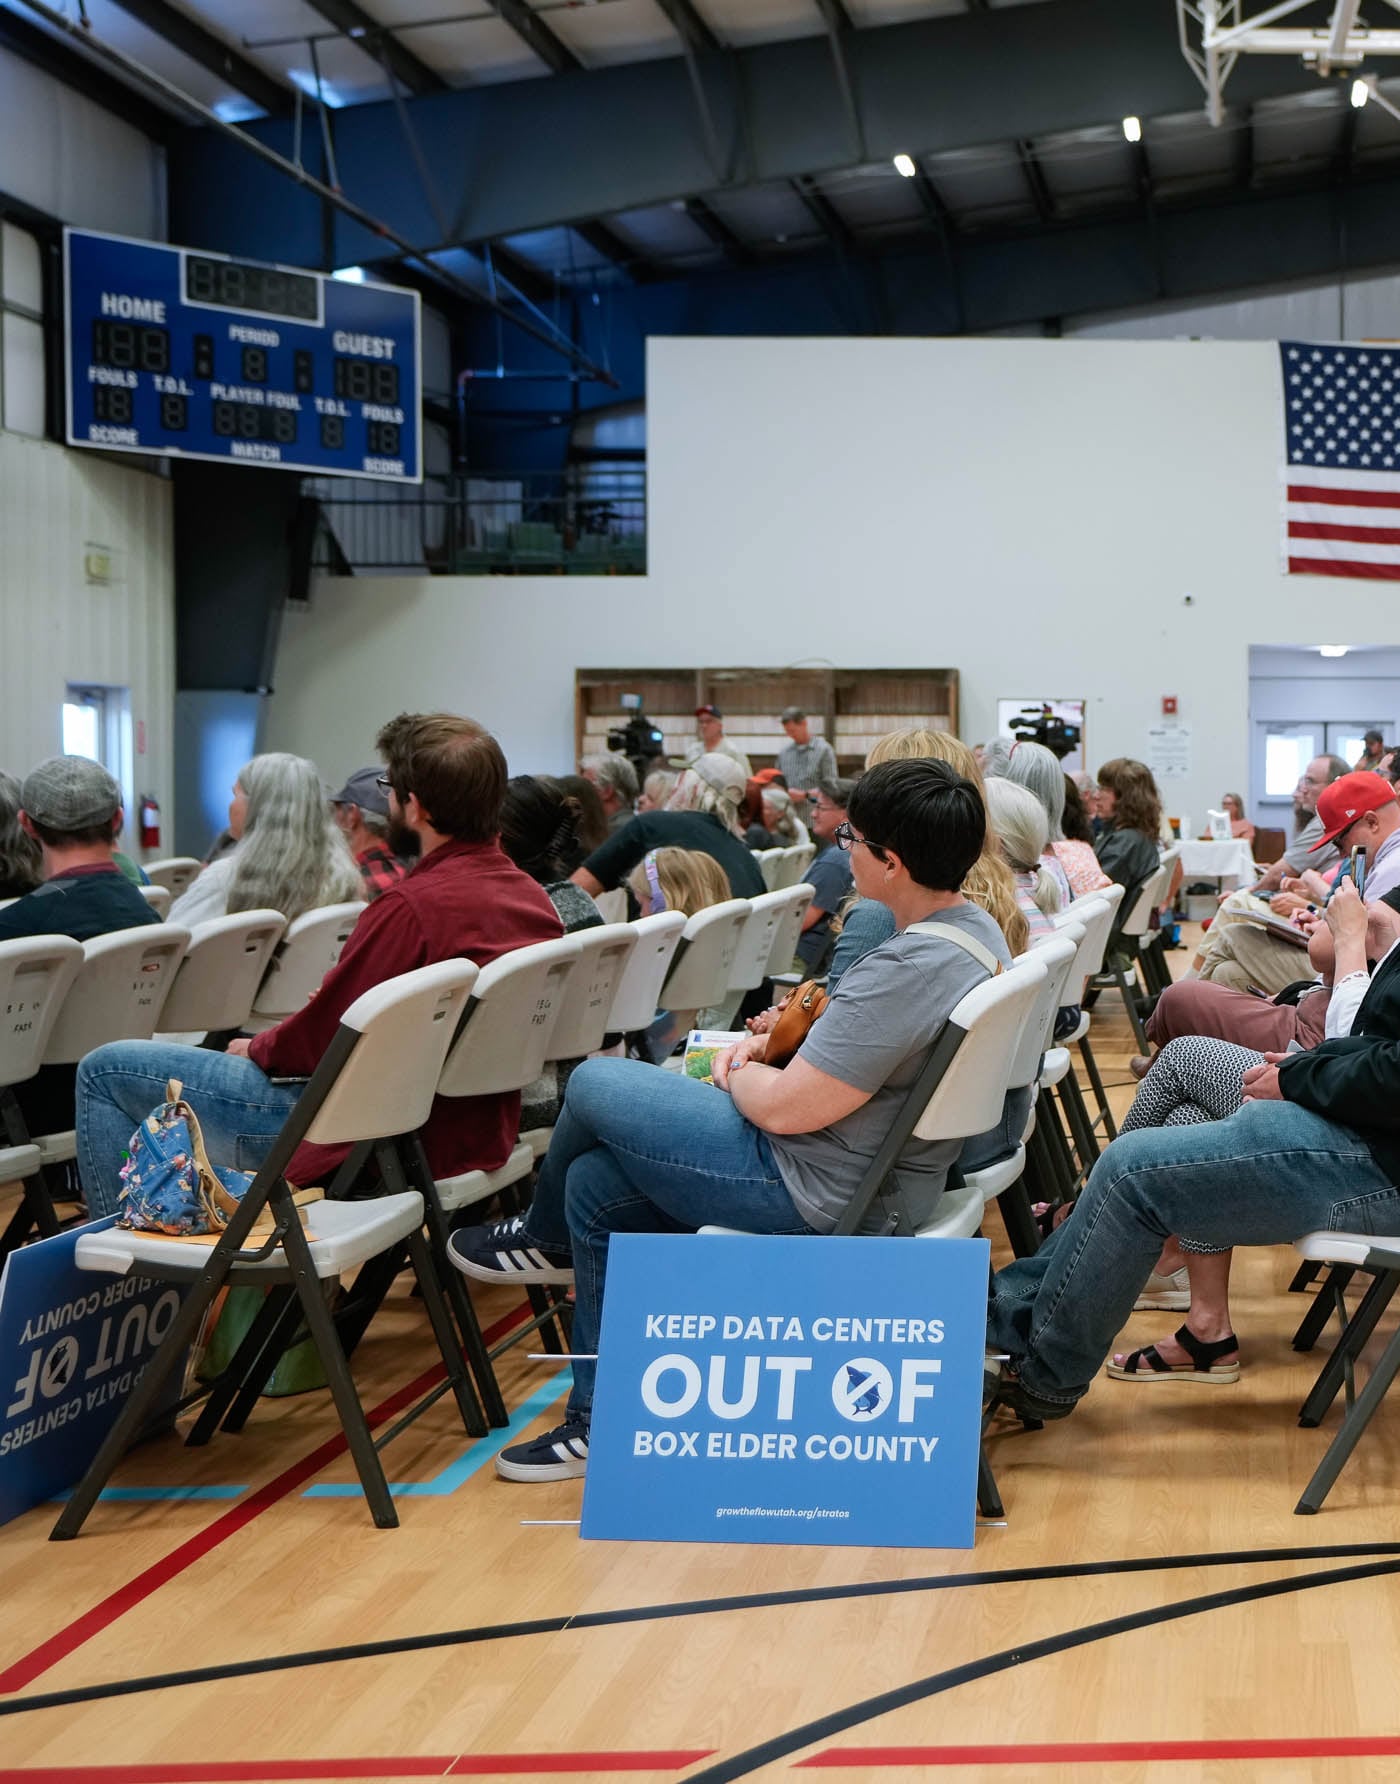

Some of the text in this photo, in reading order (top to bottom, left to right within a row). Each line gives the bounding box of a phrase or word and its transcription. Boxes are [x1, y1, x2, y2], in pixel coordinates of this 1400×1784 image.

[101, 292, 167, 323] HOME
[228, 325, 280, 348] PERIOD
[333, 330, 396, 360] GUEST
[88, 365, 138, 388] FOULS
[210, 382, 302, 411] PLAYER FOUL
[361, 403, 405, 425] FOULS
[88, 424, 139, 446] SCORE
[230, 440, 281, 461] MATCH
[362, 457, 405, 475] SCORE
[18, 1291, 101, 1346] COUNTY
[645, 1314, 945, 1344] KEEP DATA CENTERS
[6, 1289, 180, 1419] OUT OF
[86, 1371, 132, 1411] DATA
[640, 1353, 942, 1423] OUT OF
[0, 1397, 82, 1456] CENTERS
[633, 1431, 940, 1463] BOX ELDER COUNTY
[716, 1505, 850, 1521] growtheflowutah.org/stratos
